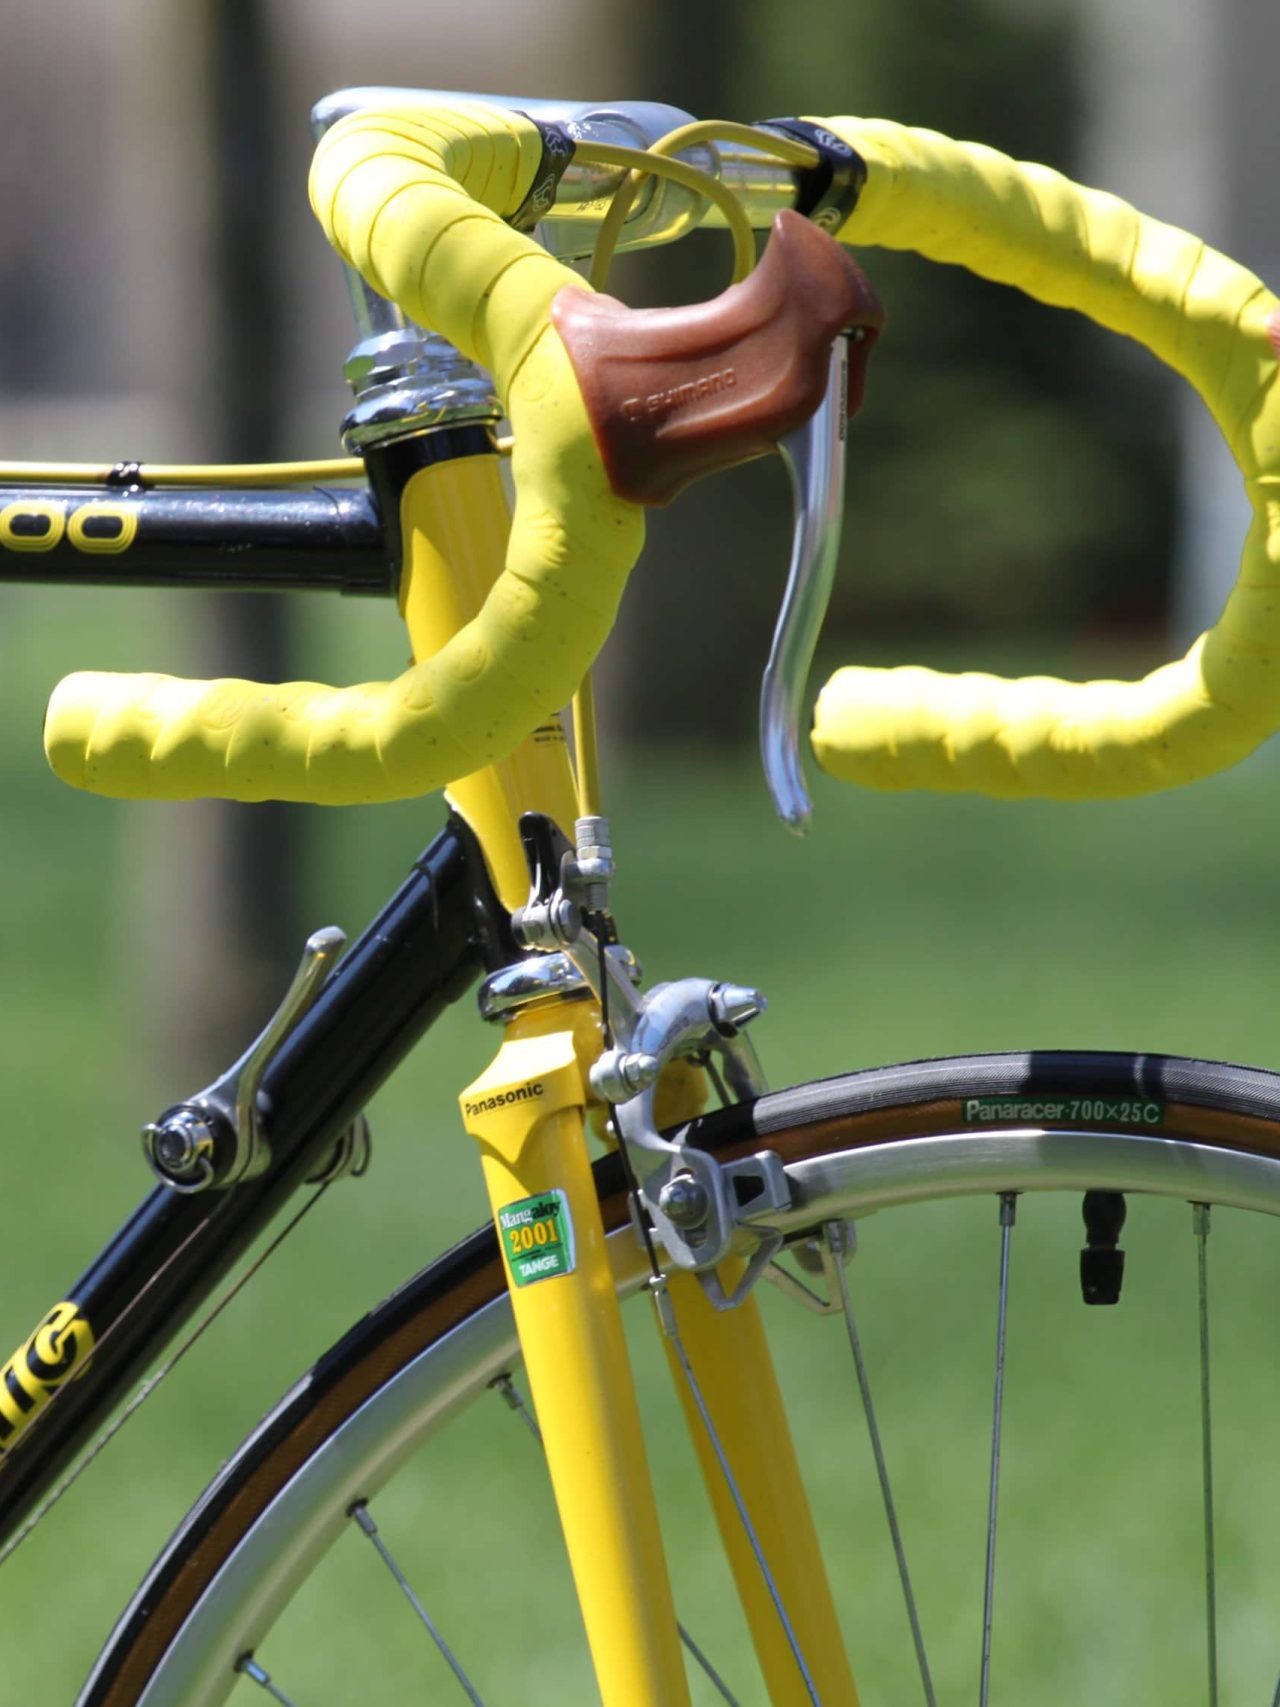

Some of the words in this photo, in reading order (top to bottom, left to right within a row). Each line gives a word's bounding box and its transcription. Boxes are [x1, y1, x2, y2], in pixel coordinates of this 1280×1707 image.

[465, 1081, 544, 1118] Panasonic
[509, 1218, 559, 1253] 2001
[519, 1254, 559, 1277] TANGE
